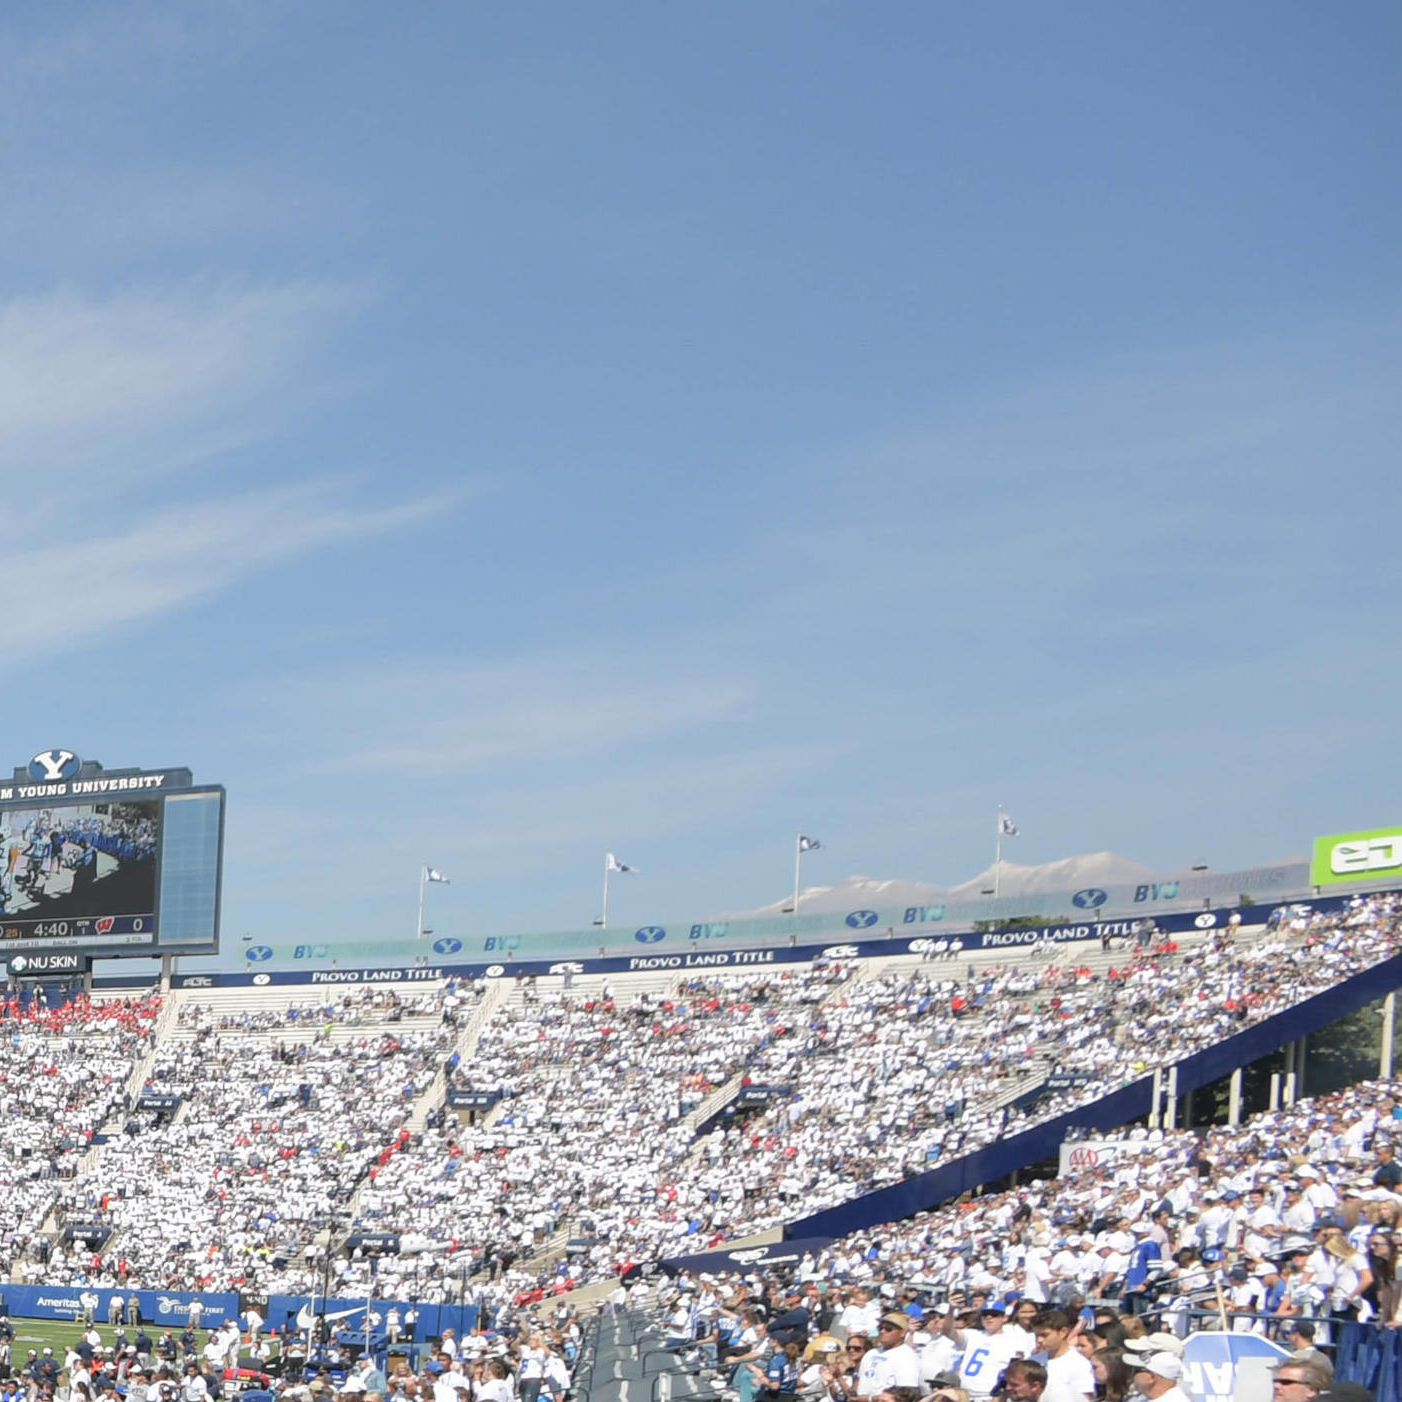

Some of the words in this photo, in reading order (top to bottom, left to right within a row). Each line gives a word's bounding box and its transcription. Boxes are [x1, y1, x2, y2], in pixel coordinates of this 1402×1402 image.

[18, 782, 68, 799] YOUNG
[72, 774, 165, 795] UNIVERSITY
[34, 922, 69, 937] 4:40
[133, 918, 143, 931] 0
[982, 930, 1037, 948] PROVO
[1041, 926, 1088, 943] LAND
[28, 957, 49, 969] NU
[51, 955, 77, 968] SKIN
[630, 955, 685, 970] PROVO
[689, 952, 727, 968] LAND
[731, 949, 773, 964] TITLE
[312, 972, 358, 983] PROVO
[363, 970, 401, 981] LAND
[406, 968, 442, 979] TITLE
[36, 1297, 81, 1308] Ameritas
[966, 1349, 990, 1377] 6
